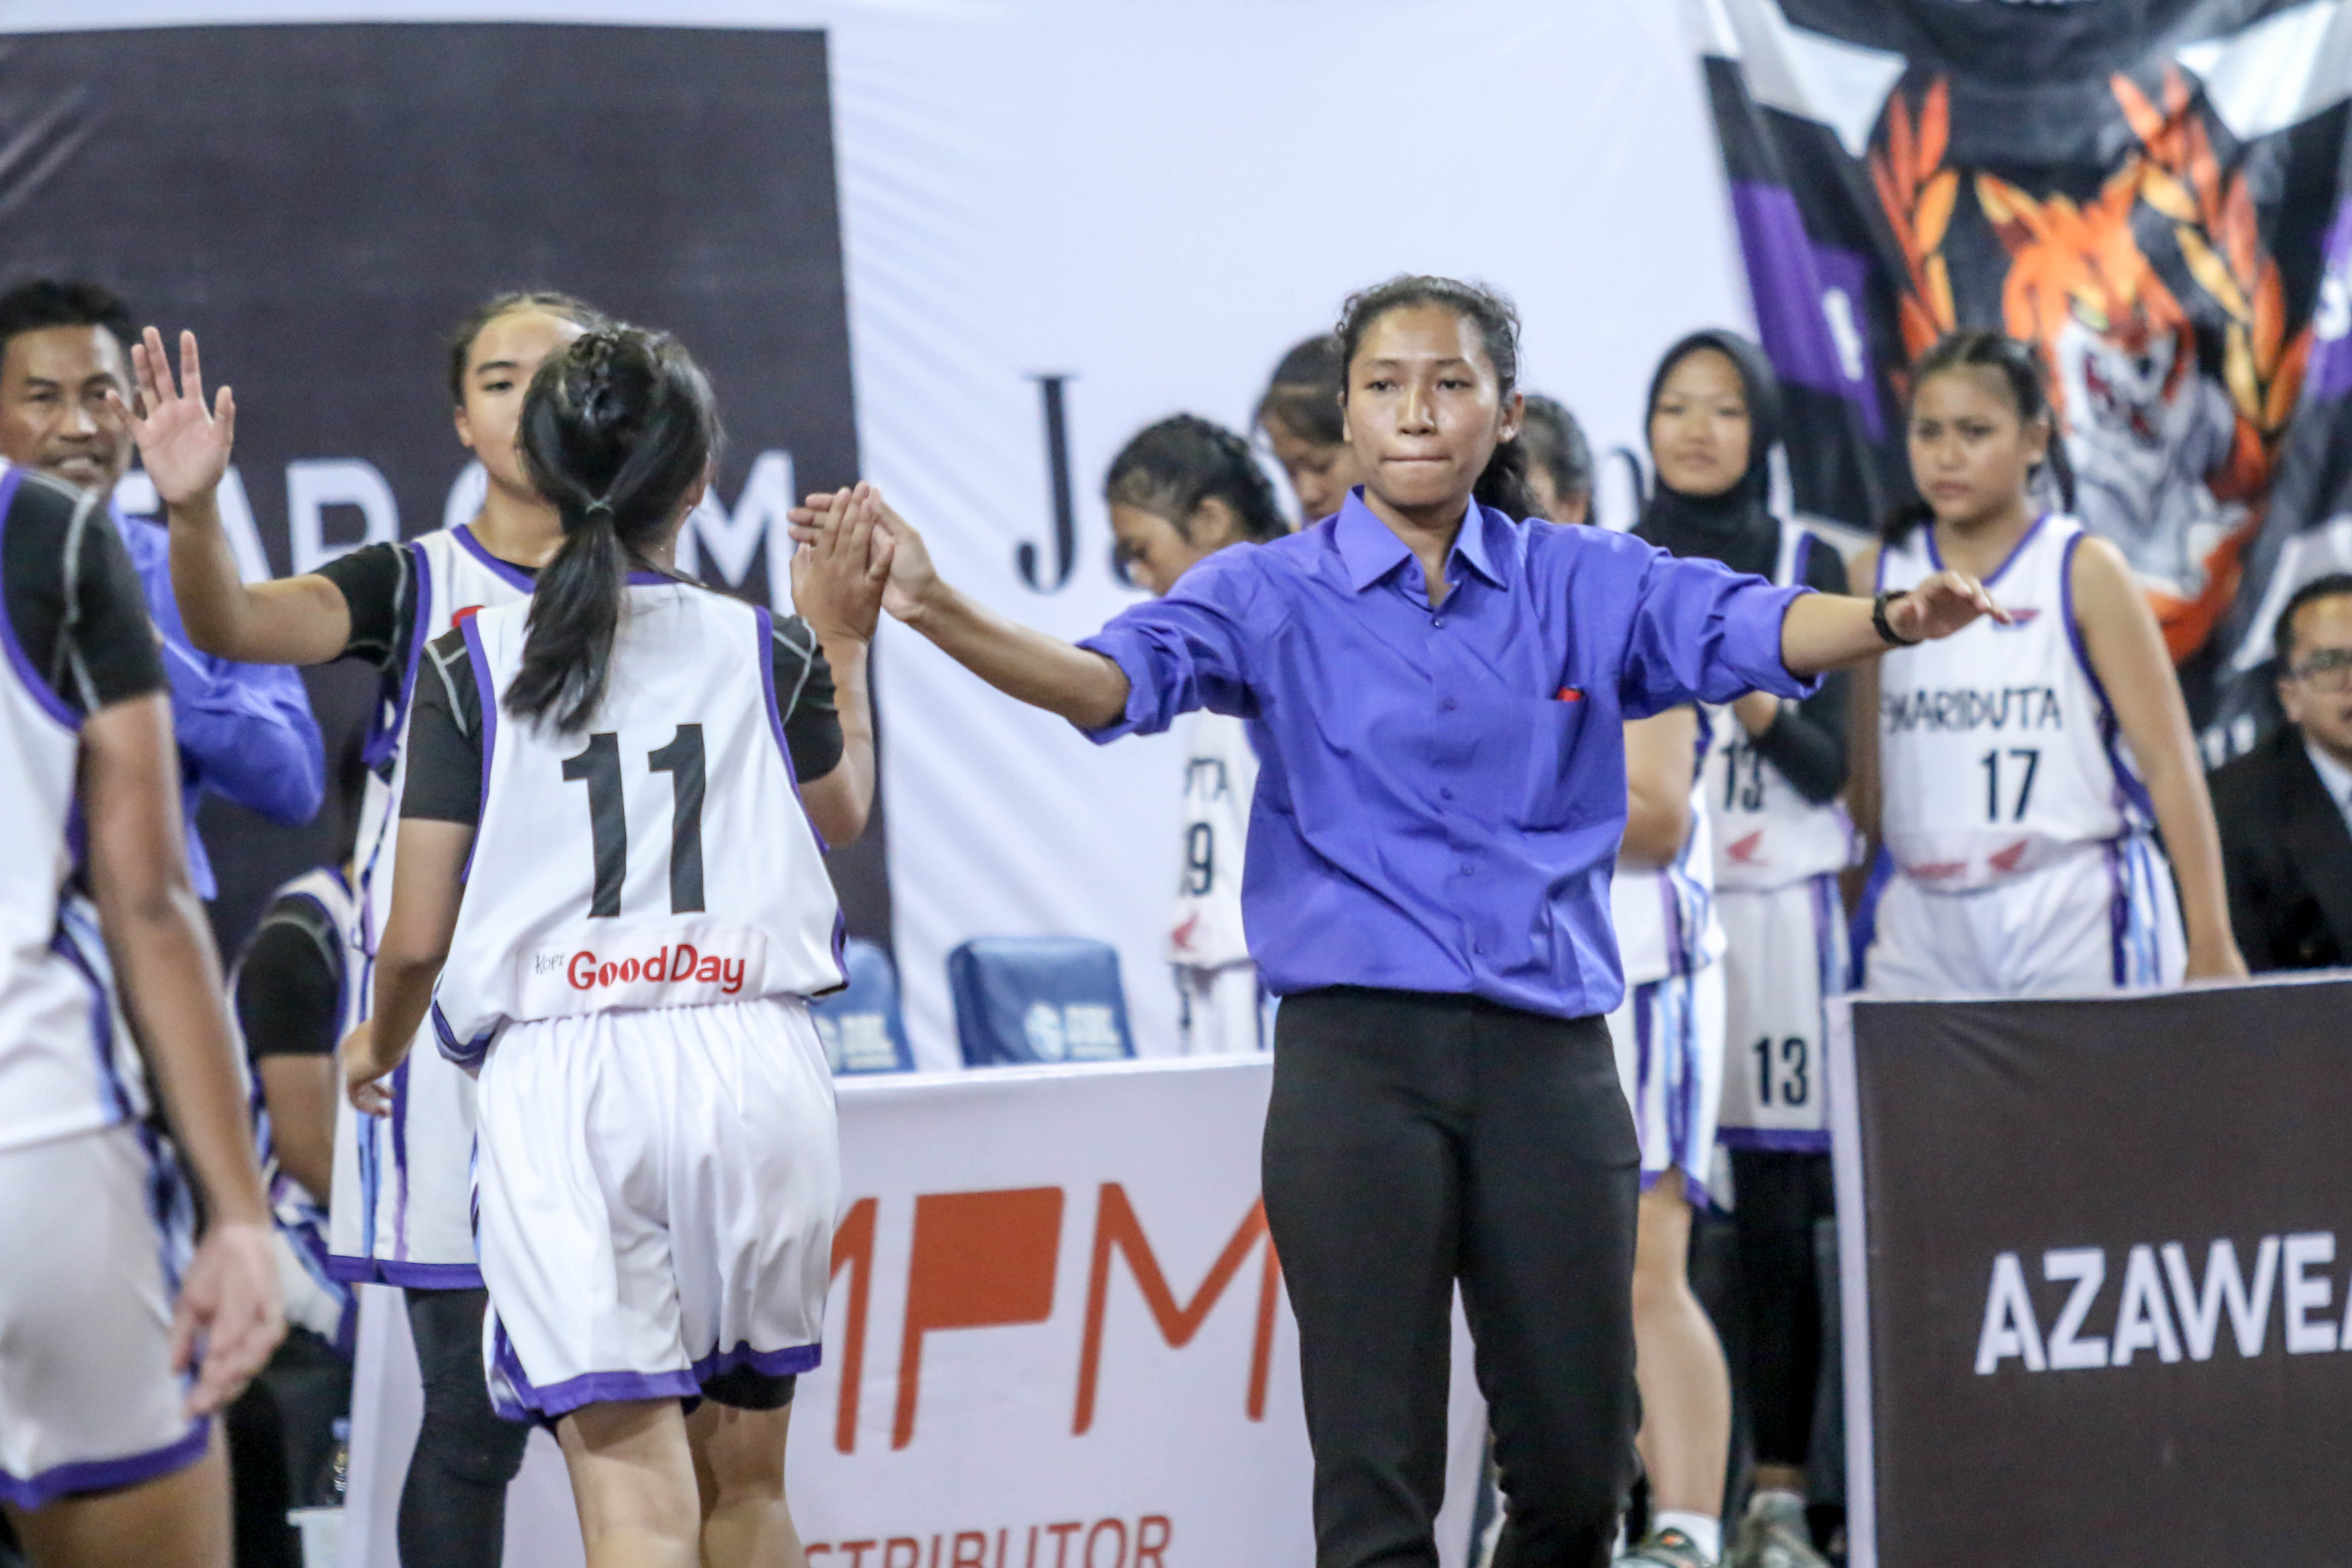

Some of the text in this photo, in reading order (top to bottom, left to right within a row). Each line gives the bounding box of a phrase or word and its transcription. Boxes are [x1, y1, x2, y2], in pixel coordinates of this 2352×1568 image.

[561, 723, 705, 919] 11
[1982, 748, 2040, 822] 17
[1754, 1037, 1808, 1106] 13
[1975, 1231, 2352, 1375] AZAWE
